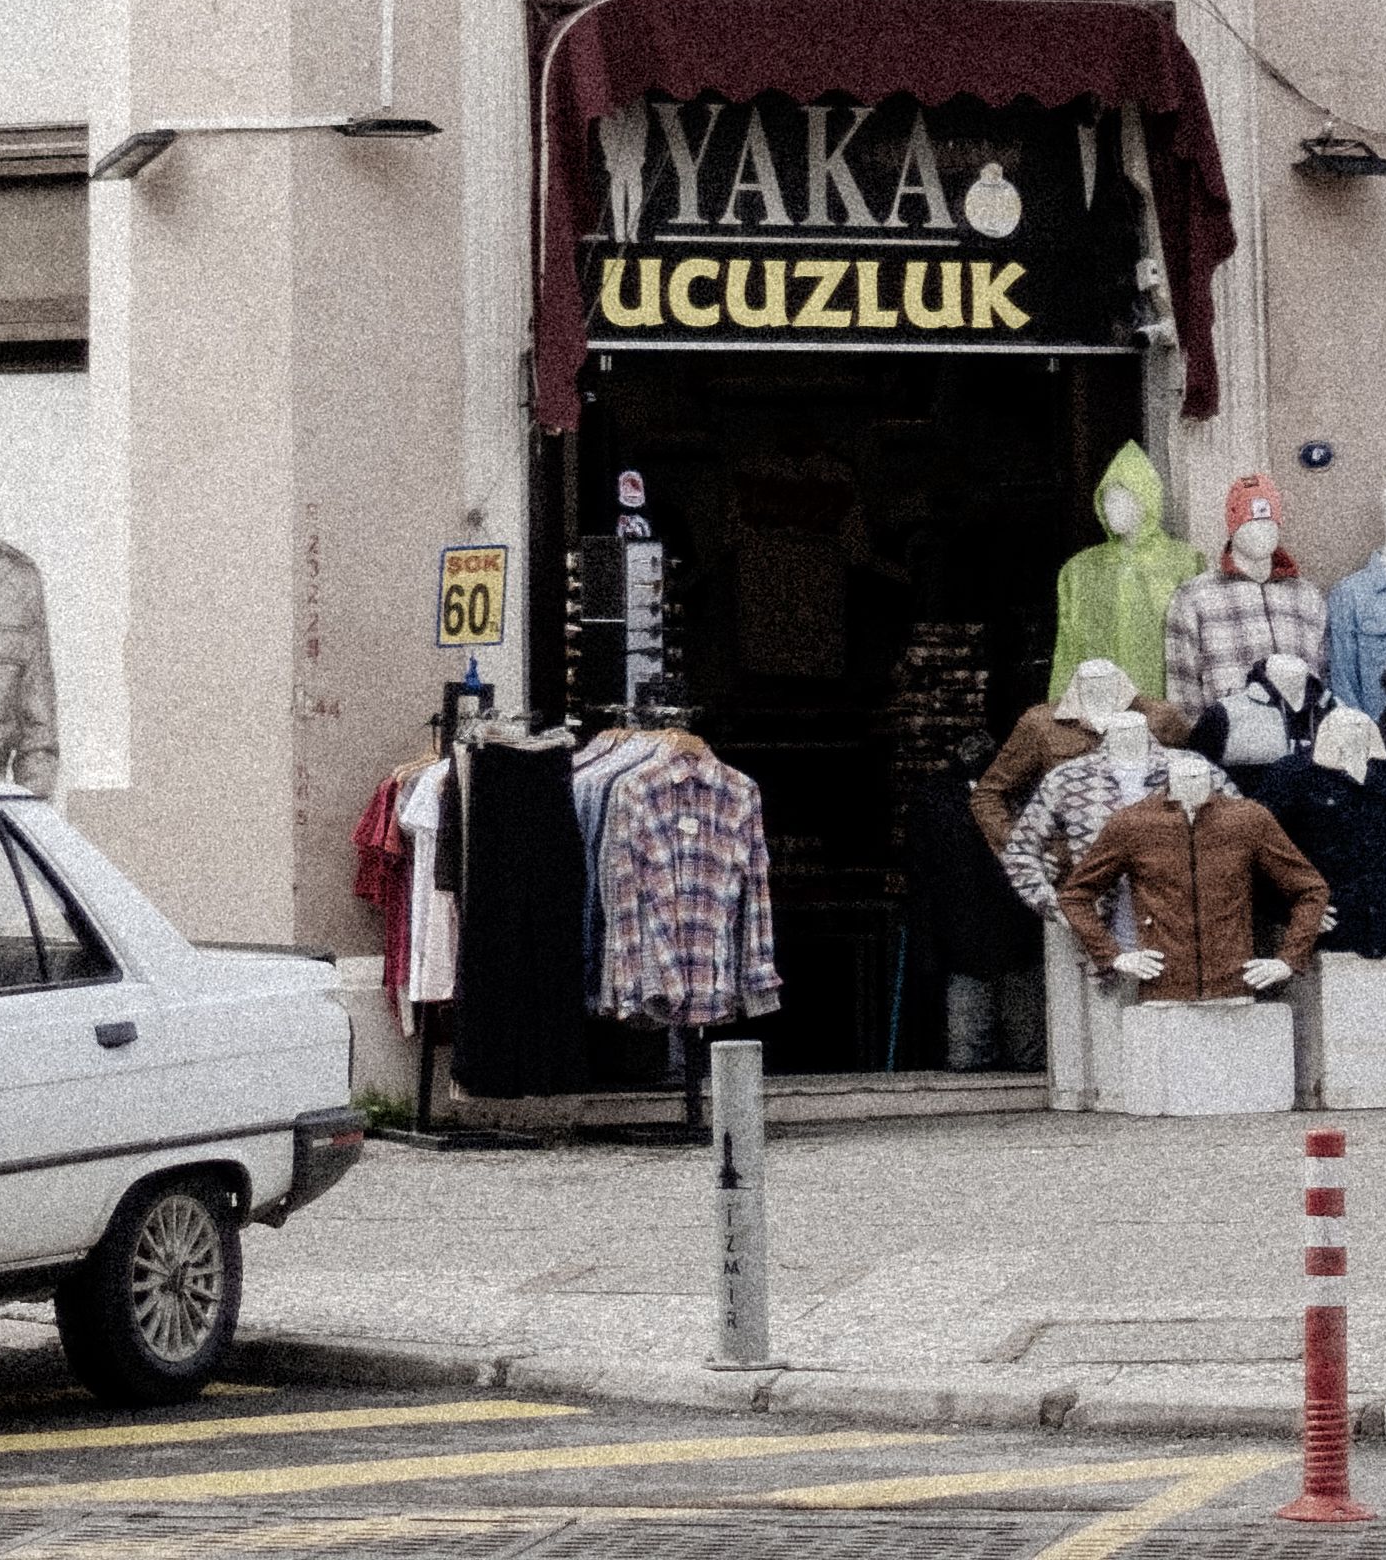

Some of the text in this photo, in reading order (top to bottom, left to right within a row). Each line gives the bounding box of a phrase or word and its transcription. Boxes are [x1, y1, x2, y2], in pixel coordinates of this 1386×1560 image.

[652, 102, 962, 228] YAKA
[599, 256, 1032, 330] UCUZLUK
[723, 1203, 741, 1329] İZMİR
